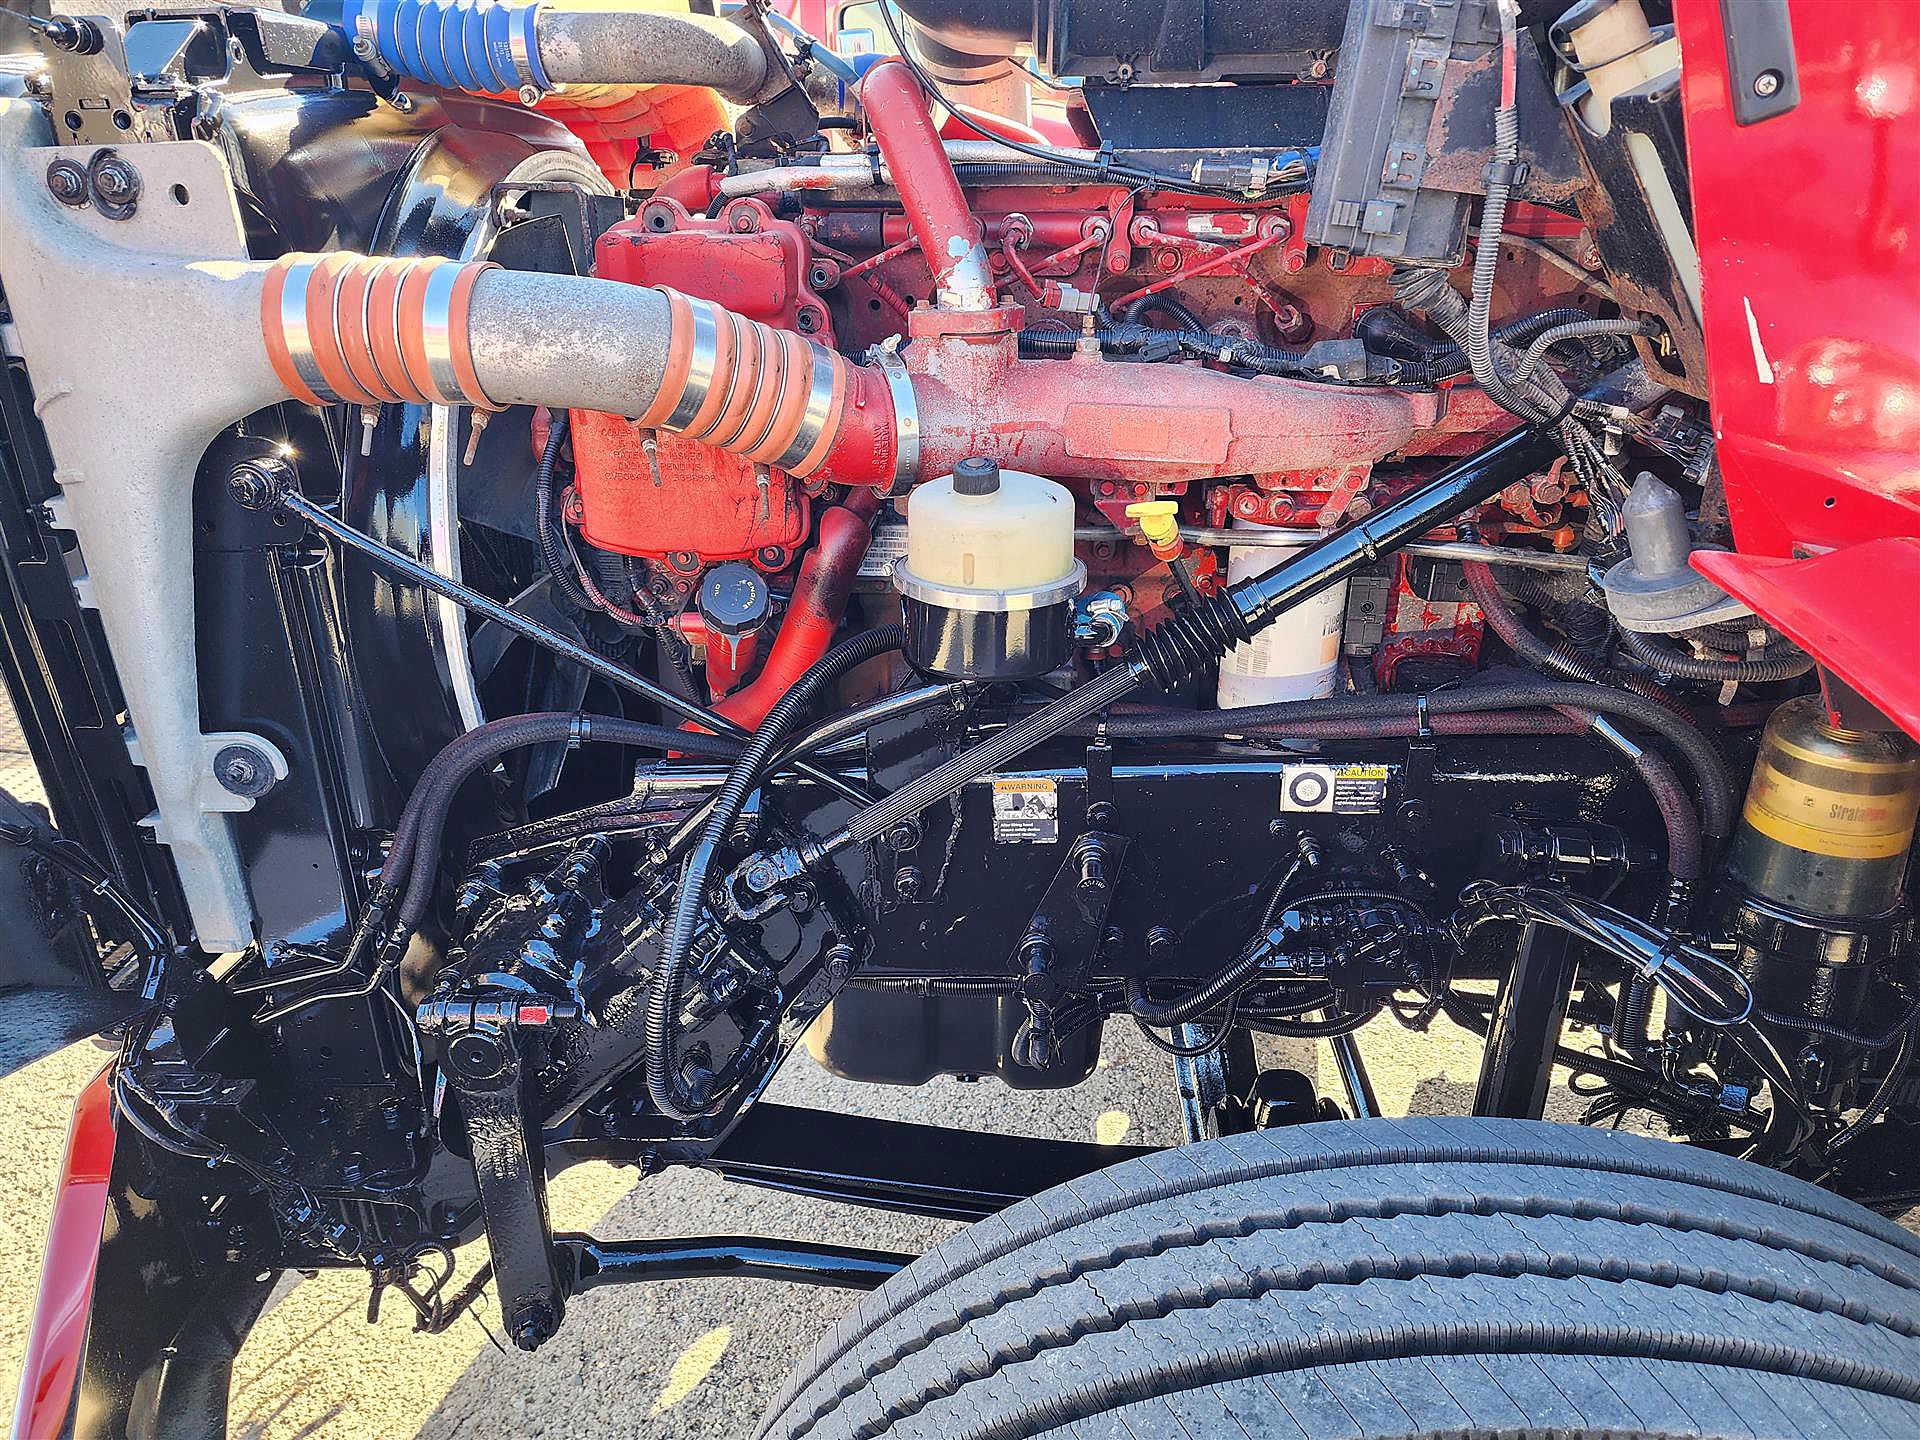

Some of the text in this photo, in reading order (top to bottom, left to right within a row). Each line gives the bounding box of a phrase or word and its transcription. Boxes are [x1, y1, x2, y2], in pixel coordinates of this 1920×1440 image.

[713, 583, 721, 597] OIL
[742, 581, 756, 610] ENGINE
[1345, 770, 1384, 778] CAUTION
